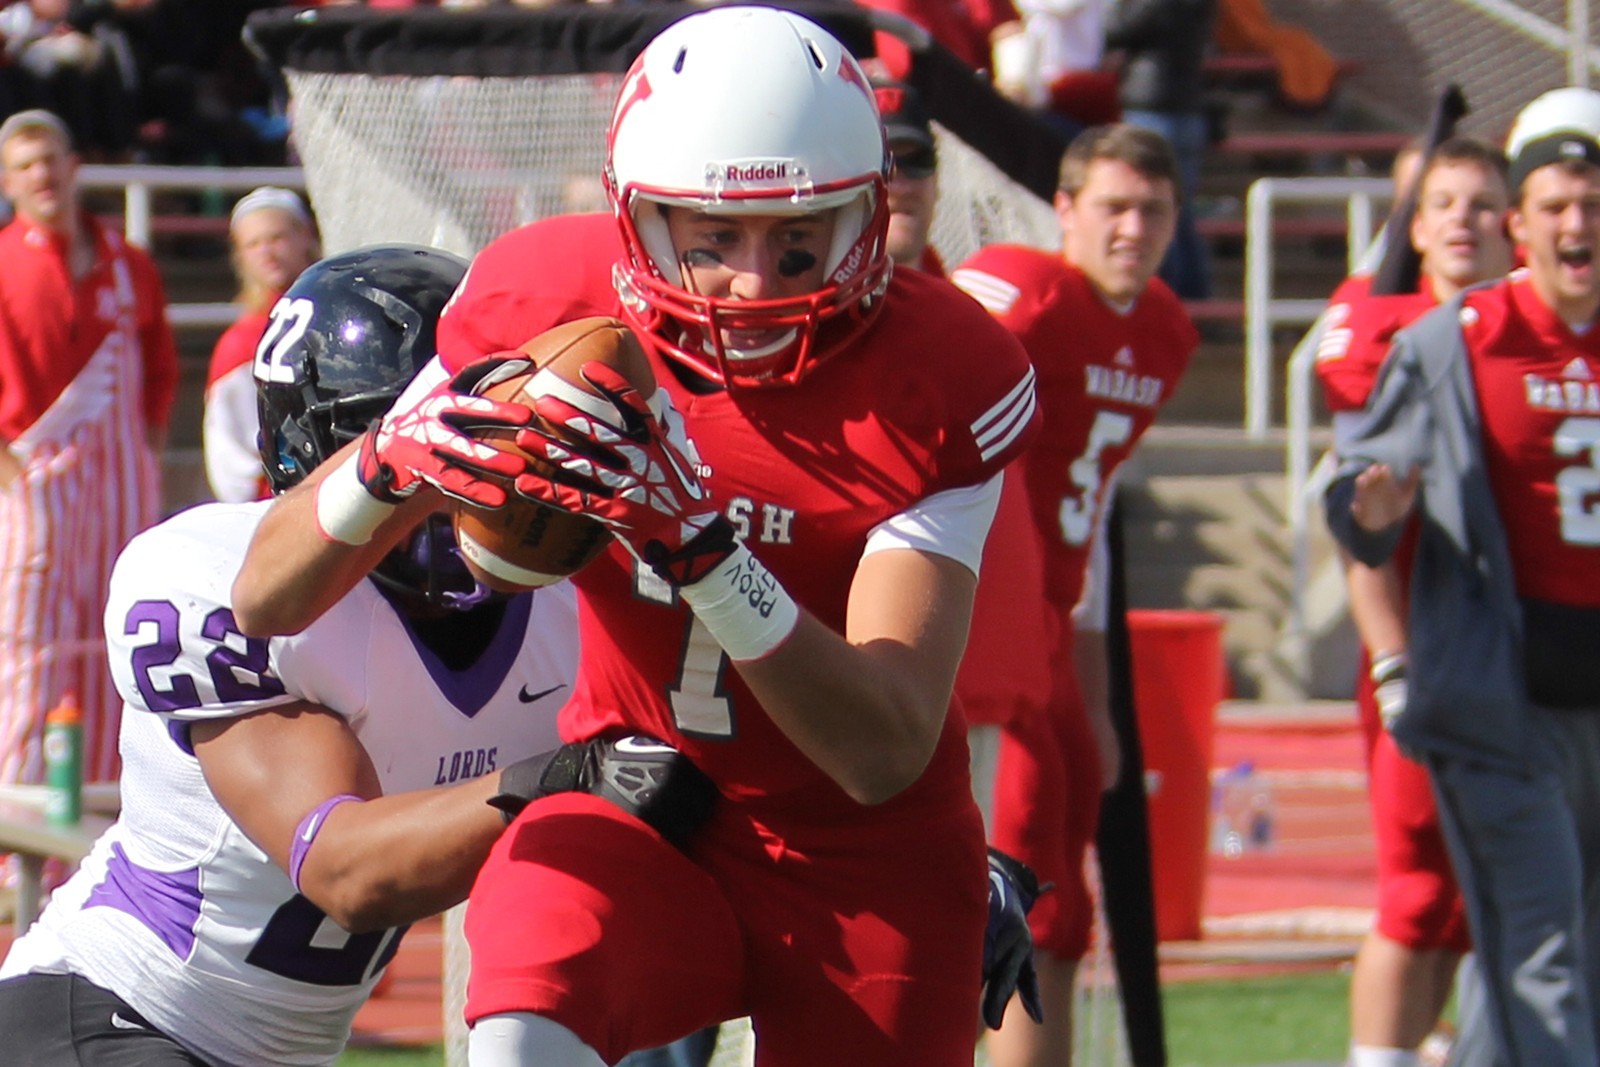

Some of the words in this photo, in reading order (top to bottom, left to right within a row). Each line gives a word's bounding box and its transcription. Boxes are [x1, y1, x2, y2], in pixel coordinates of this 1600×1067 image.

[726, 163, 786, 181] Riddell
[833, 241, 865, 284] Ridd
[253, 297, 314, 384] 22
[1059, 410, 1133, 546] 5
[723, 563, 777, 618] PROV
[124, 599, 288, 712] 22
[434, 746, 498, 785] LORDS
